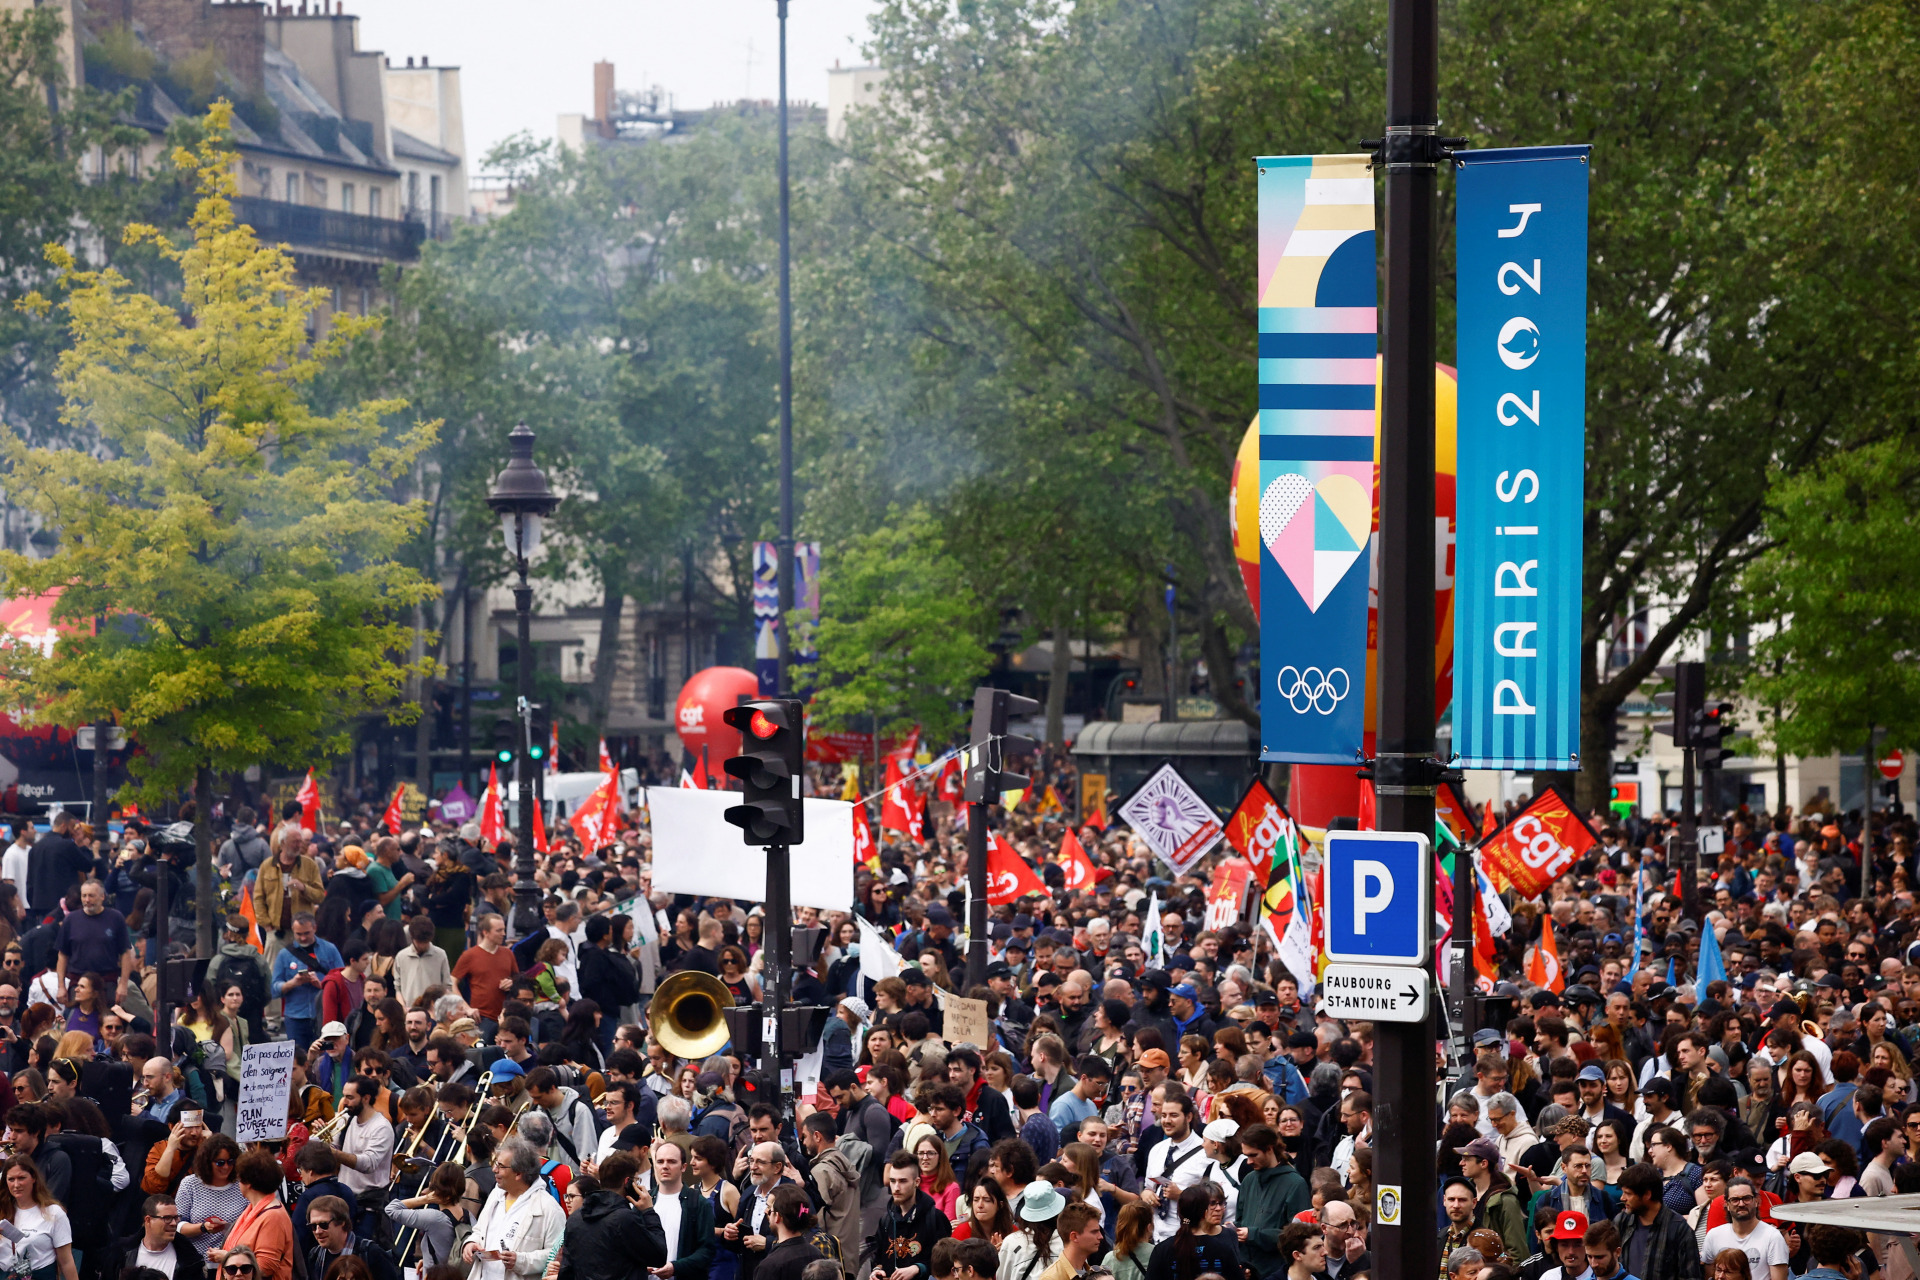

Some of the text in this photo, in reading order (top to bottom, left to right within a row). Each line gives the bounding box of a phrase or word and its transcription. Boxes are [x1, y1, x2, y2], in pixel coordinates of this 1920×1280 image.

[1496, 203, 1542, 427] 2024
[680, 704, 704, 727] cgt
[1239, 800, 1272, 847] la
[1248, 802, 1290, 866] cgt
[1533, 810, 1576, 858] la
[1512, 815, 1575, 878] cgt
[1353, 859, 1395, 935] P
[1327, 976, 1391, 990] FAUBOURG
[1327, 995, 1397, 1010] ST-ANTOINE
[259, 1050, 272, 1064] pas
[273, 1046, 293, 1059] choisi
[238, 1118, 283, 1133] D'URGENCE
[240, 1107, 262, 1122] PLAN
[252, 1128, 267, 1139] 93
